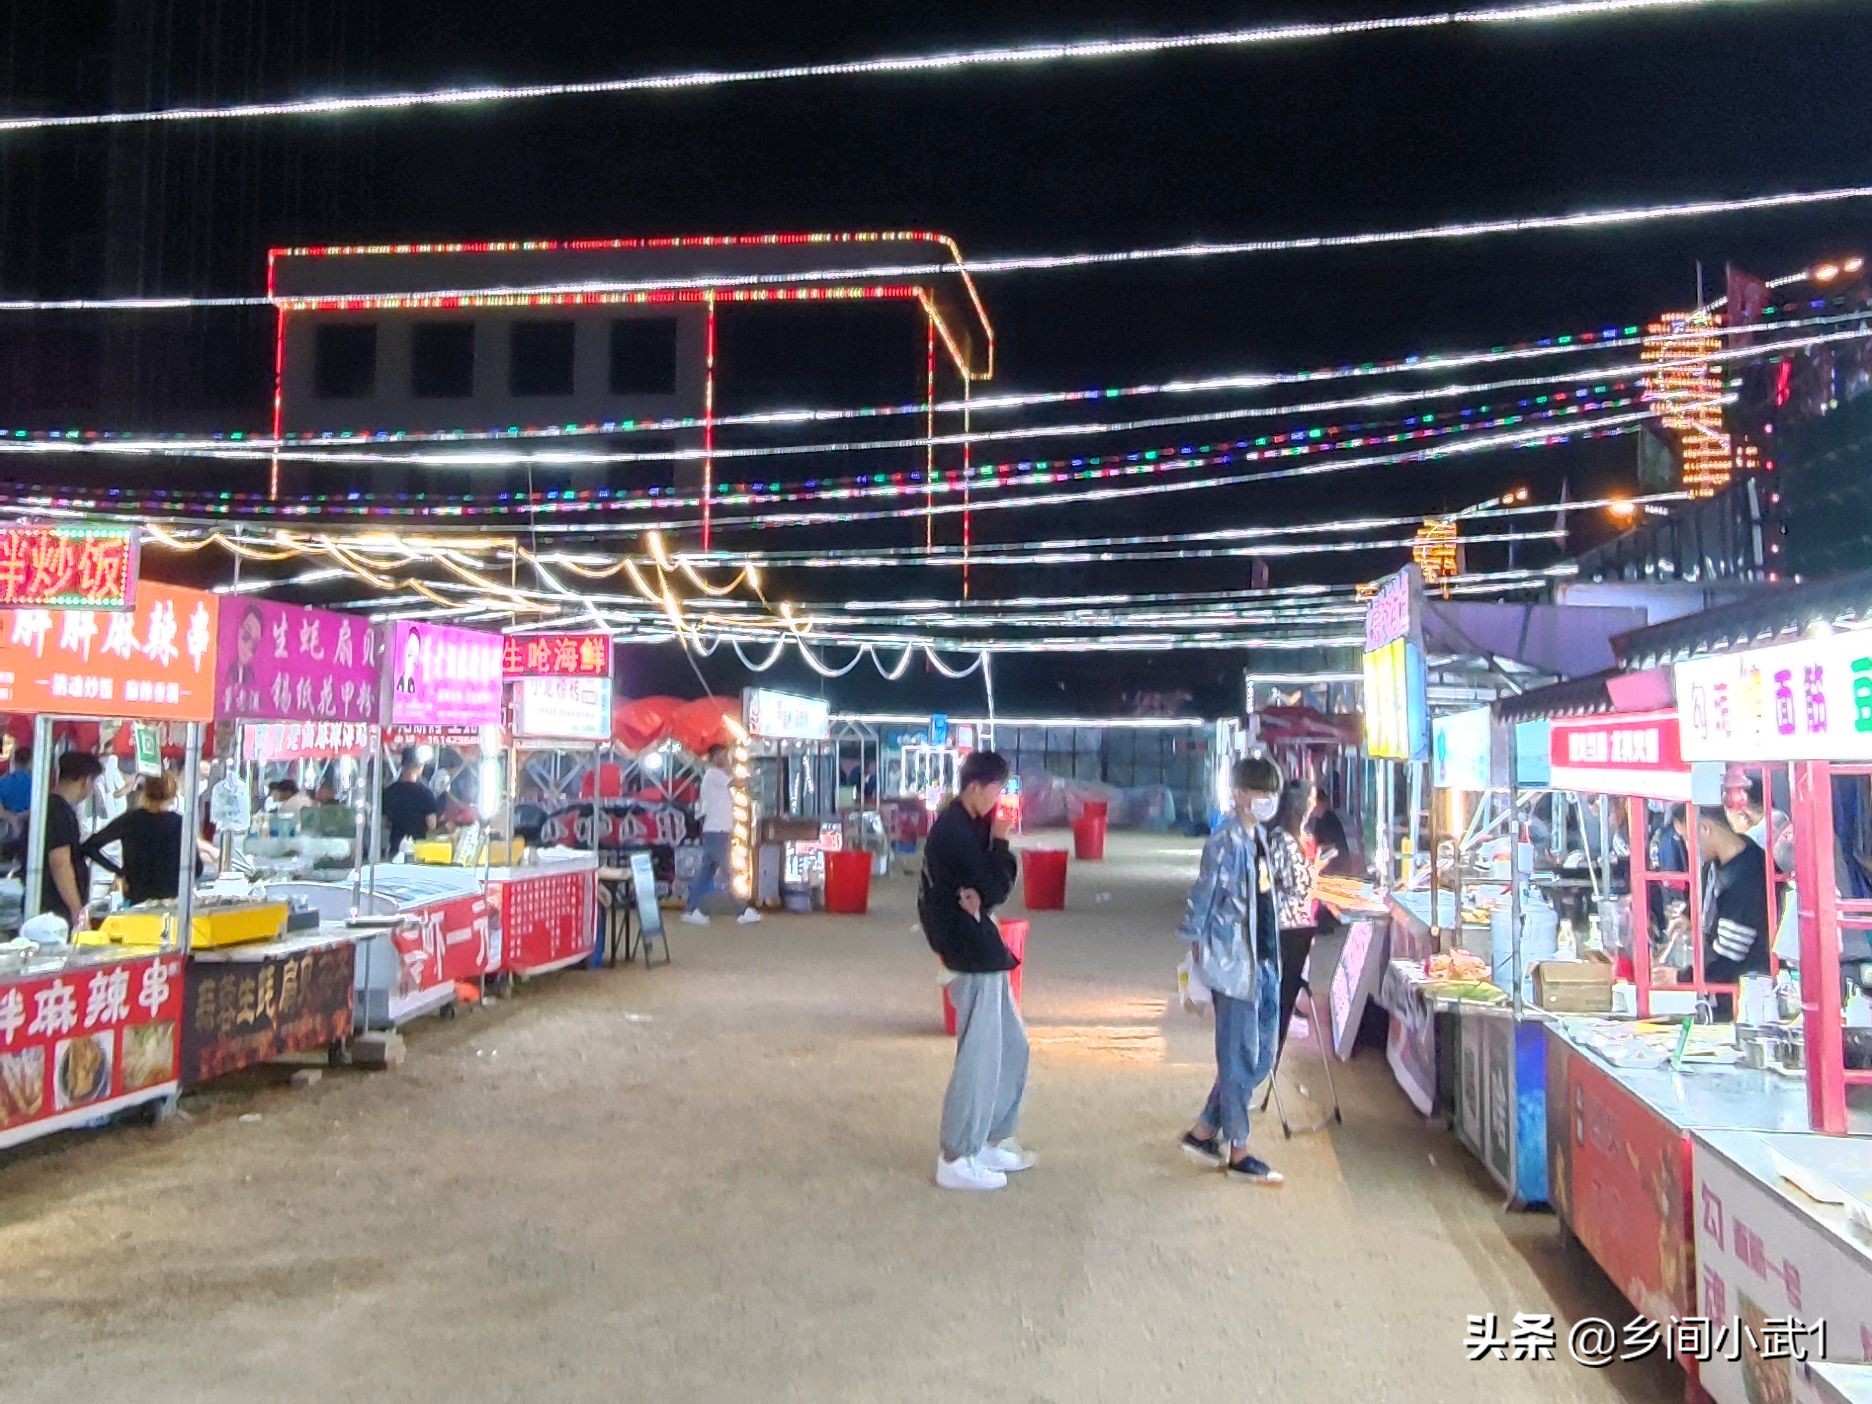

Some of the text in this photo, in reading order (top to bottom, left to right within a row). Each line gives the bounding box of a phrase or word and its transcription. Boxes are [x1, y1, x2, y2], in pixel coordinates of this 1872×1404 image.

[272, 611, 376, 668] 生蚝扇贝
[504, 637, 606, 673] 生呛海鲜
